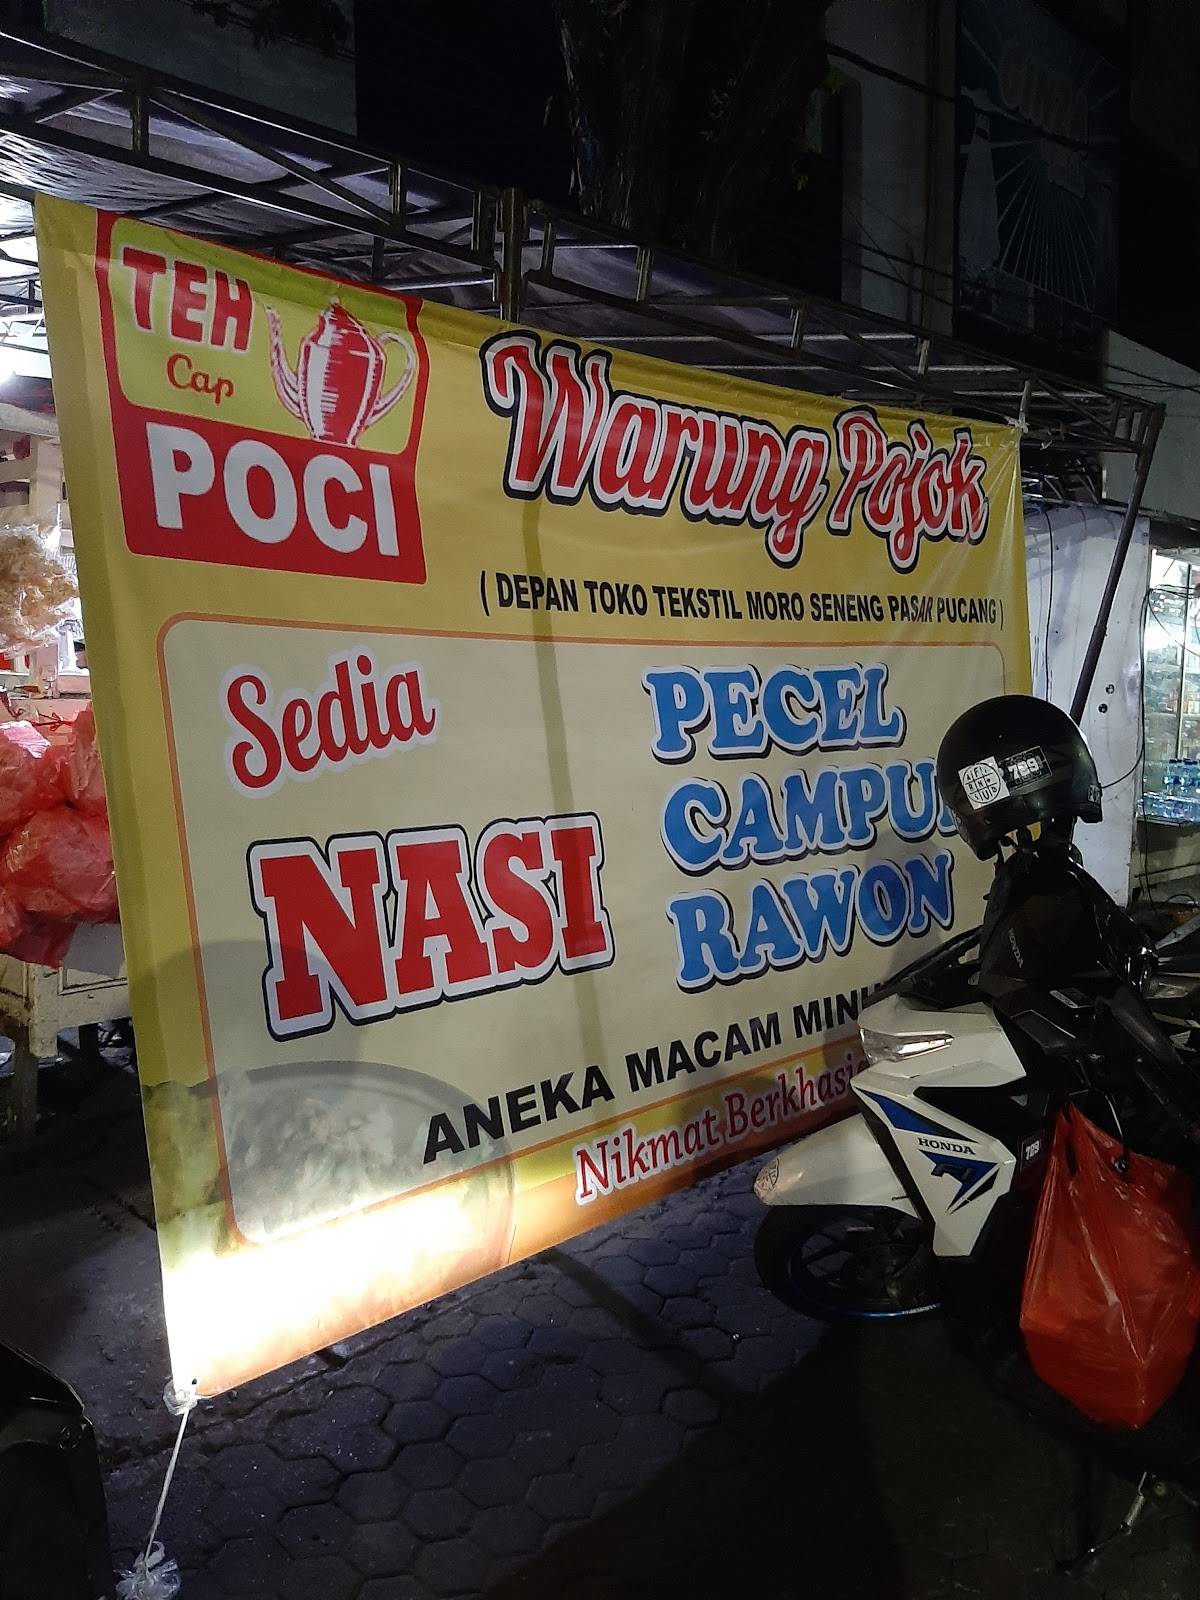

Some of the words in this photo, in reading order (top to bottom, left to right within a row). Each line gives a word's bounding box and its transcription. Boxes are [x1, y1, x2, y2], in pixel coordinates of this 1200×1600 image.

[122, 246, 253, 353] TEH
[167, 353, 234, 405] Cap
[145, 422, 400, 557] POCI
[482, 331, 829, 567] Warung
[828, 406, 988, 572] Pojok
[495, 572, 579, 613] DEPAN
[583, 580, 648, 616] TOKO
[652, 585, 743, 620] TEKSTIL
[746, 590, 805, 621] MORO
[810, 592, 884, 623] SENENG
[887, 594, 934, 623] PASAR
[937, 596, 997, 625] PUCANG
[226, 653, 436, 790] Sedia
[643, 663, 905, 765] PECEL
[662, 755, 958, 877] CAMPU
[249, 813, 615, 1041] NASI
[668, 850, 954, 993] RAWON
[423, 1064, 615, 1165] ANEKA
[625, 1011, 783, 1093] MACAM
[917, 1137, 976, 1156] HONDA
[577, 1109, 720, 1202] Nikmat
